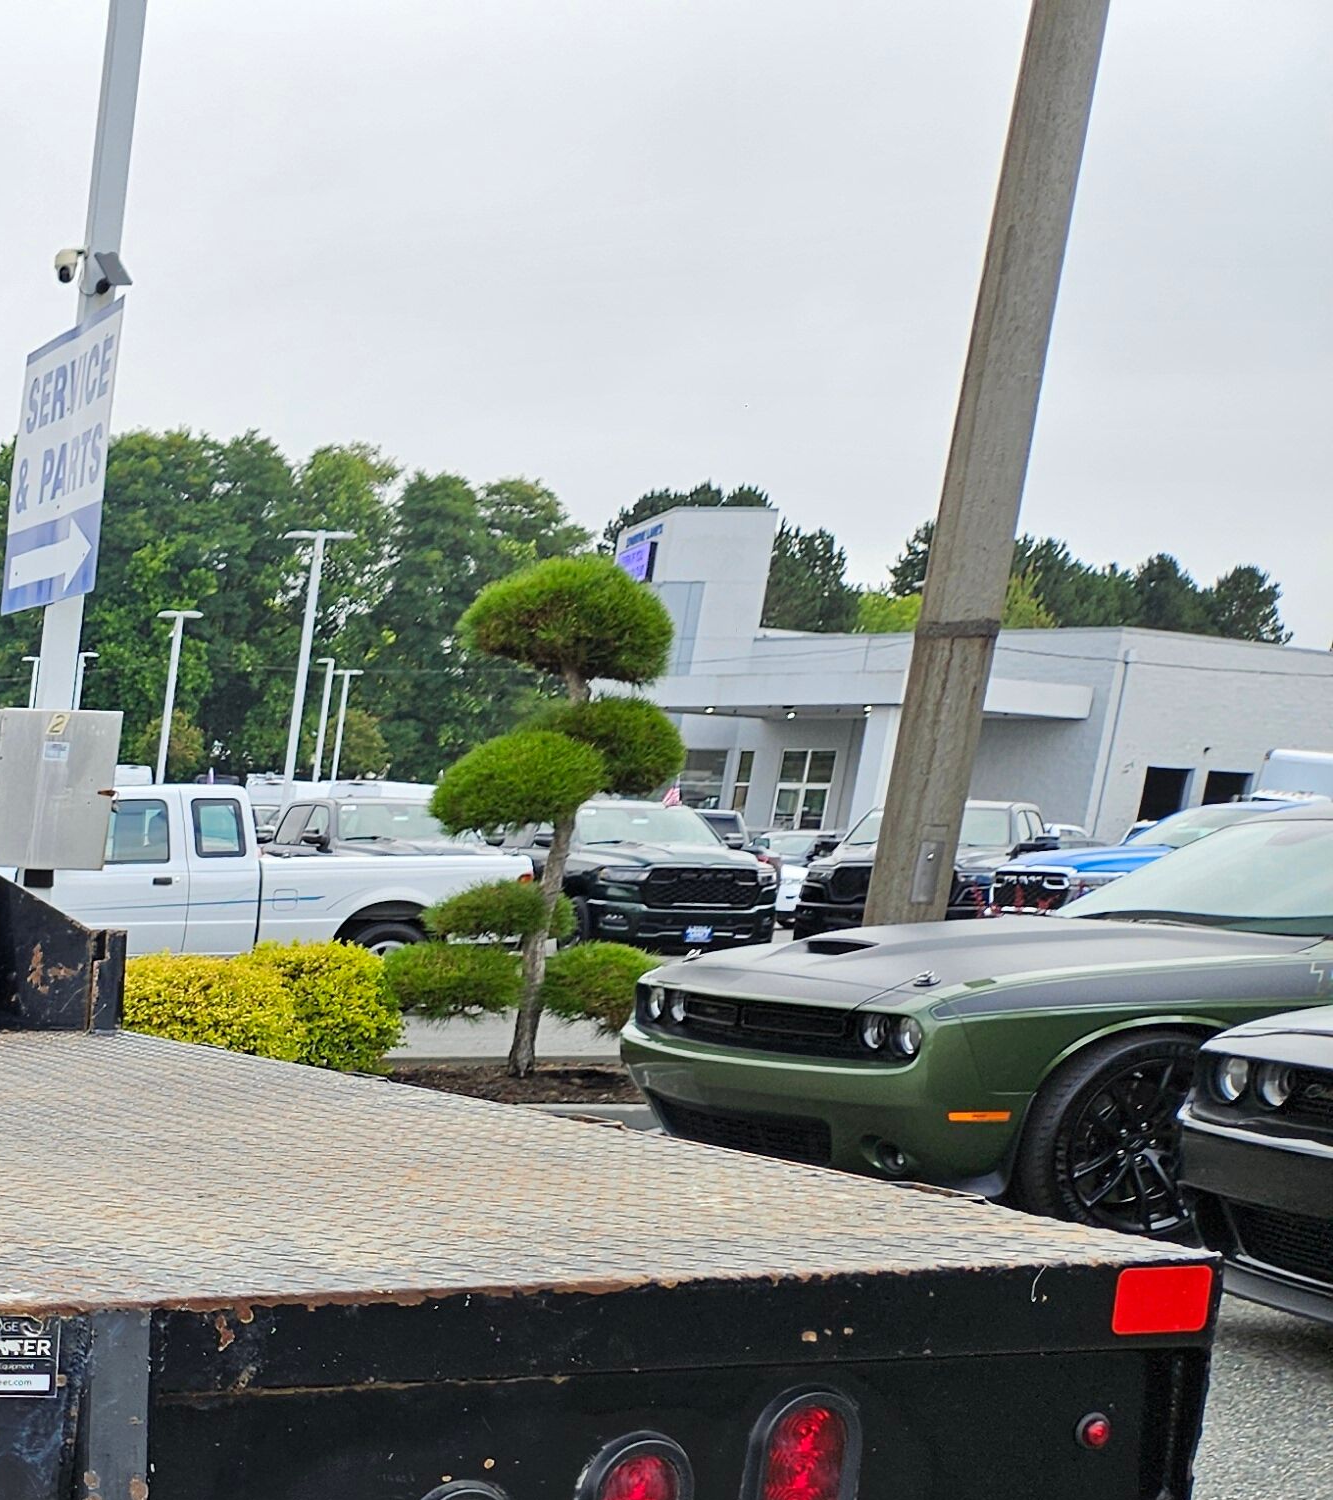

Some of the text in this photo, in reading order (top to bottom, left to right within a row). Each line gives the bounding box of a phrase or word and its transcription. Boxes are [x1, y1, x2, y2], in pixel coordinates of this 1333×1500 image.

[26, 335, 115, 435] SERVICE
[15, 422, 103, 514] & PARTS
[48, 714, 65, 733] 2
